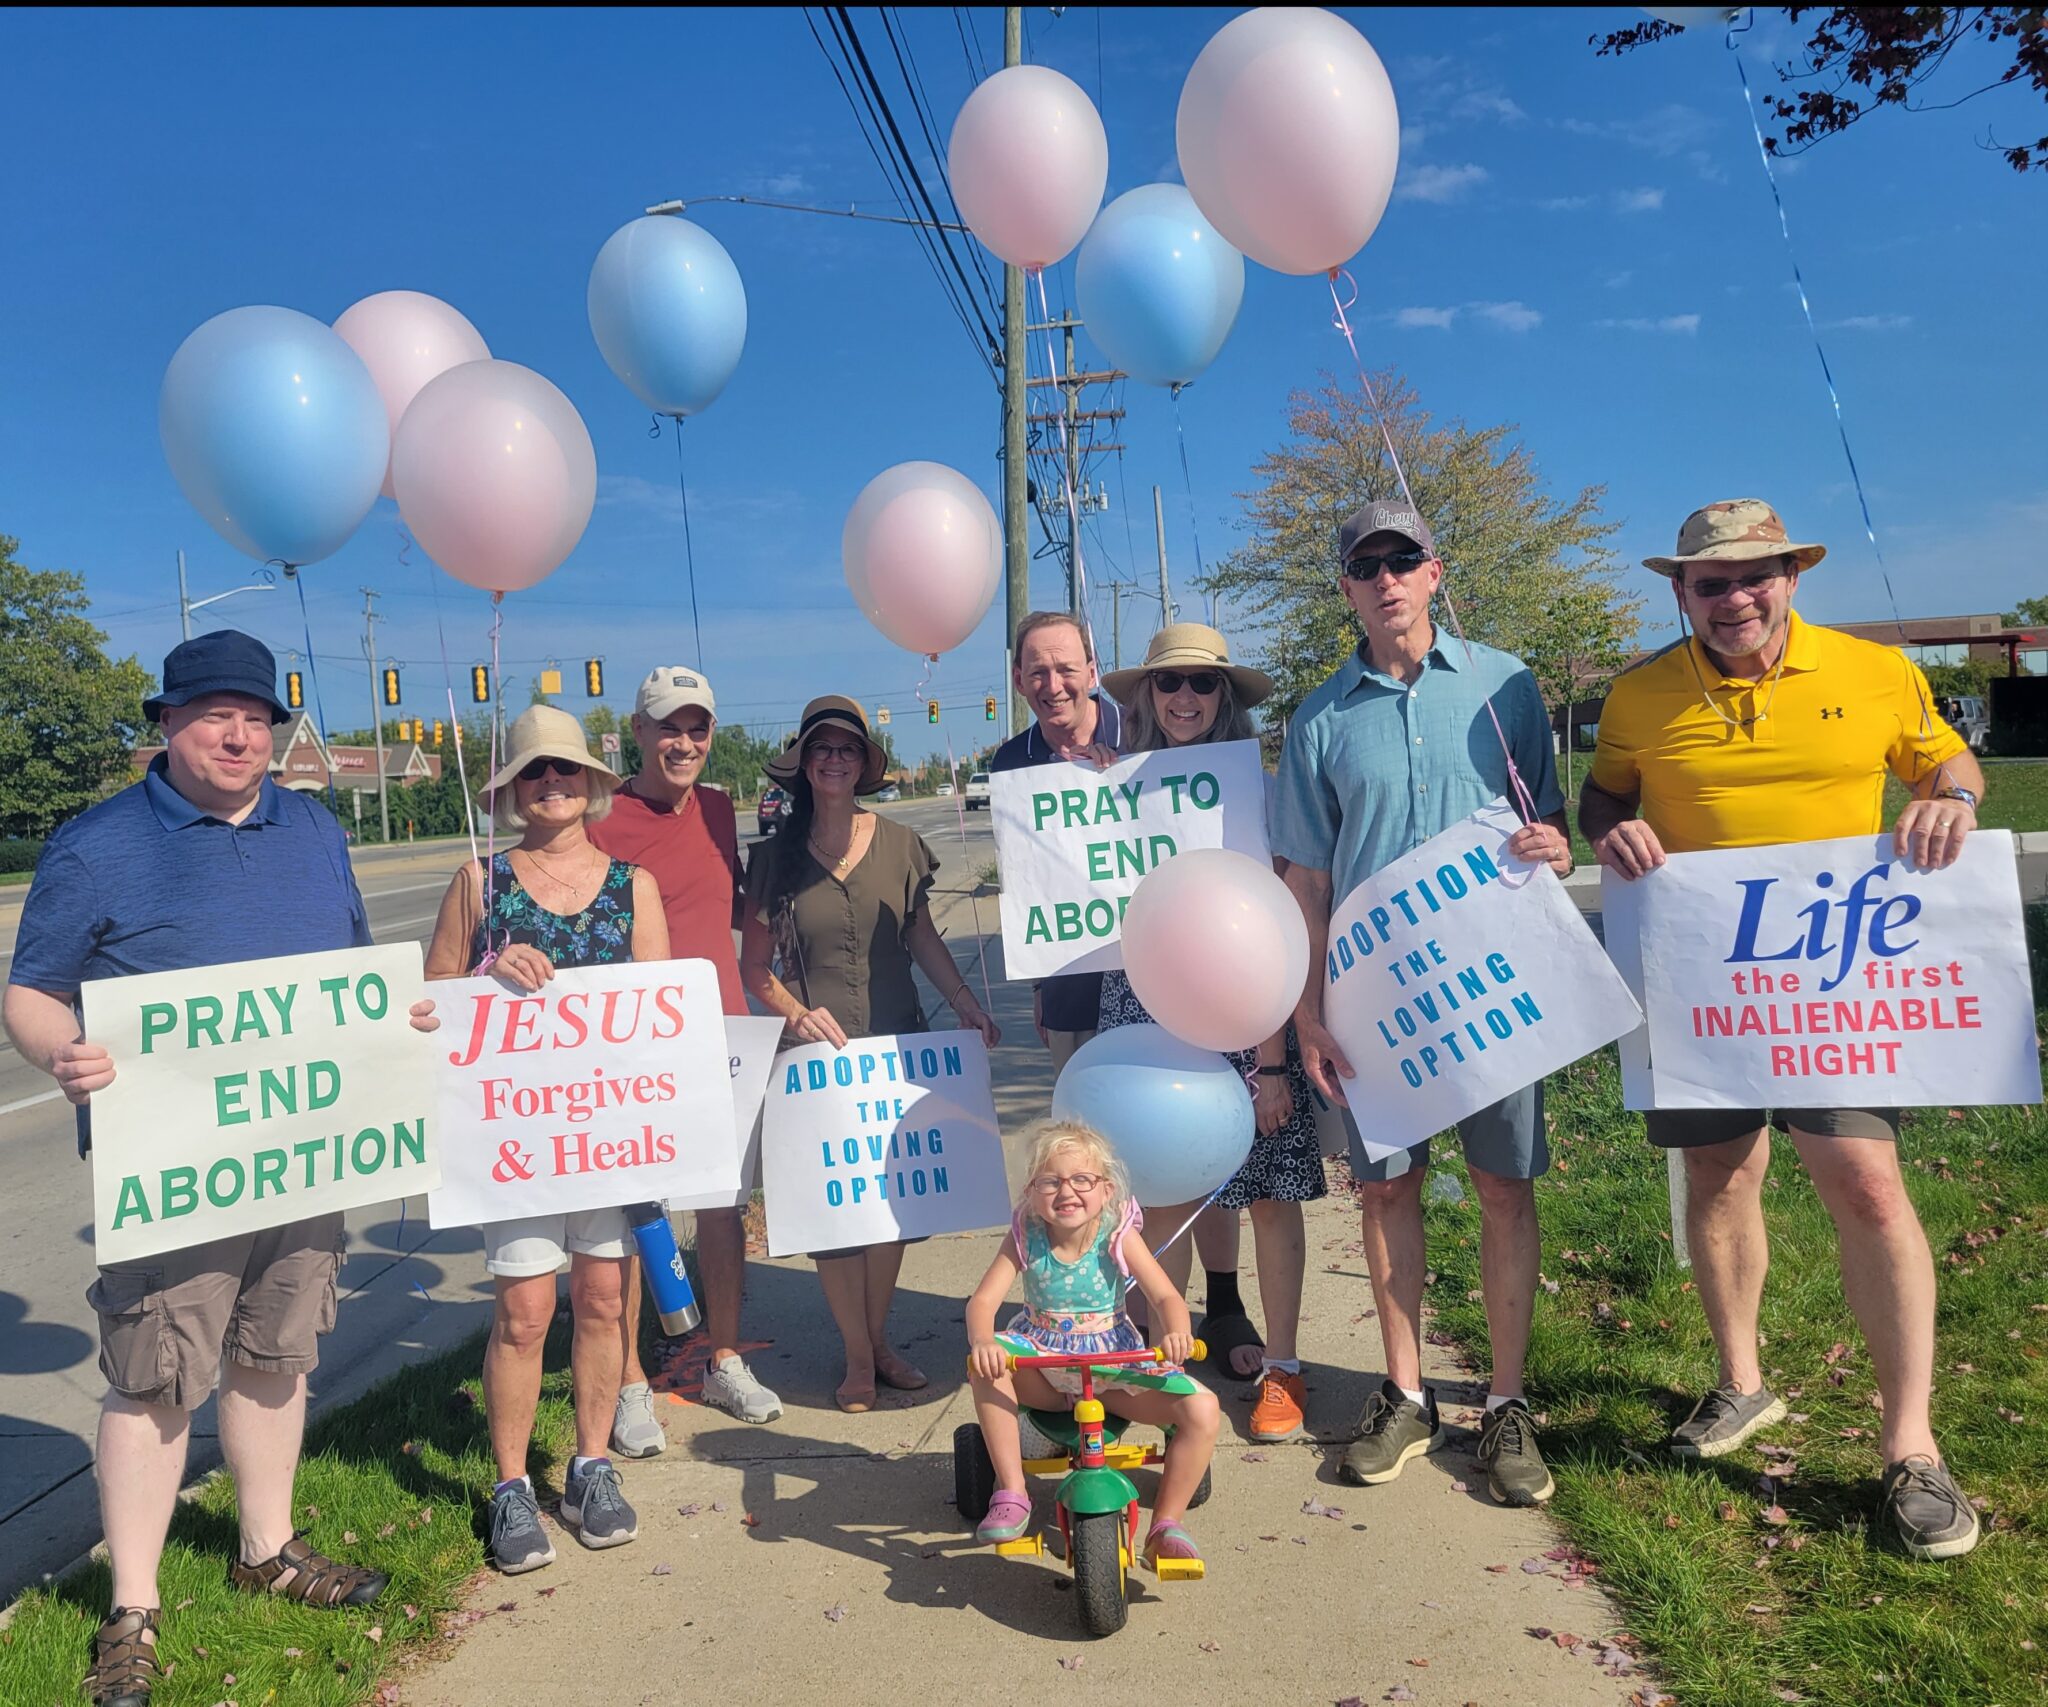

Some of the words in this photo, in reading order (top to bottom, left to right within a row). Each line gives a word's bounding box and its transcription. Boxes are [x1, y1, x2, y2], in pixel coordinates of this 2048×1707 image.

[1373, 507, 1419, 531] Chevy
[1032, 781, 1142, 831] PRAY
[1161, 771, 1220, 813] TO
[1086, 834, 1178, 881] END
[1328, 845, 1499, 985] ADOPTION
[1723, 863, 1921, 992] Life
[1388, 938, 1448, 987] THE
[1732, 967, 1800, 995] the
[1864, 961, 1964, 989] first
[140, 984, 297, 1054] PRAY
[319, 973, 388, 1026] TO
[449, 985, 684, 1066] JESUS
[1376, 952, 1516, 1048] LOVING
[1692, 996, 1982, 1037] INALIENABLE
[1400, 991, 1544, 1089] OPTION
[1771, 1041, 1902, 1077] RIGHT
[214, 1060, 341, 1127] END
[479, 1068, 676, 1122] Forgives
[785, 1046, 963, 1095] ADOPTION
[857, 1099, 905, 1122] THE
[111, 1118, 426, 1229] ABORTION
[492, 1140, 535, 1182] &
[550, 1125, 676, 1176] Heals
[822, 1127, 944, 1168] LOVING
[826, 1166, 950, 1208] OPTION
